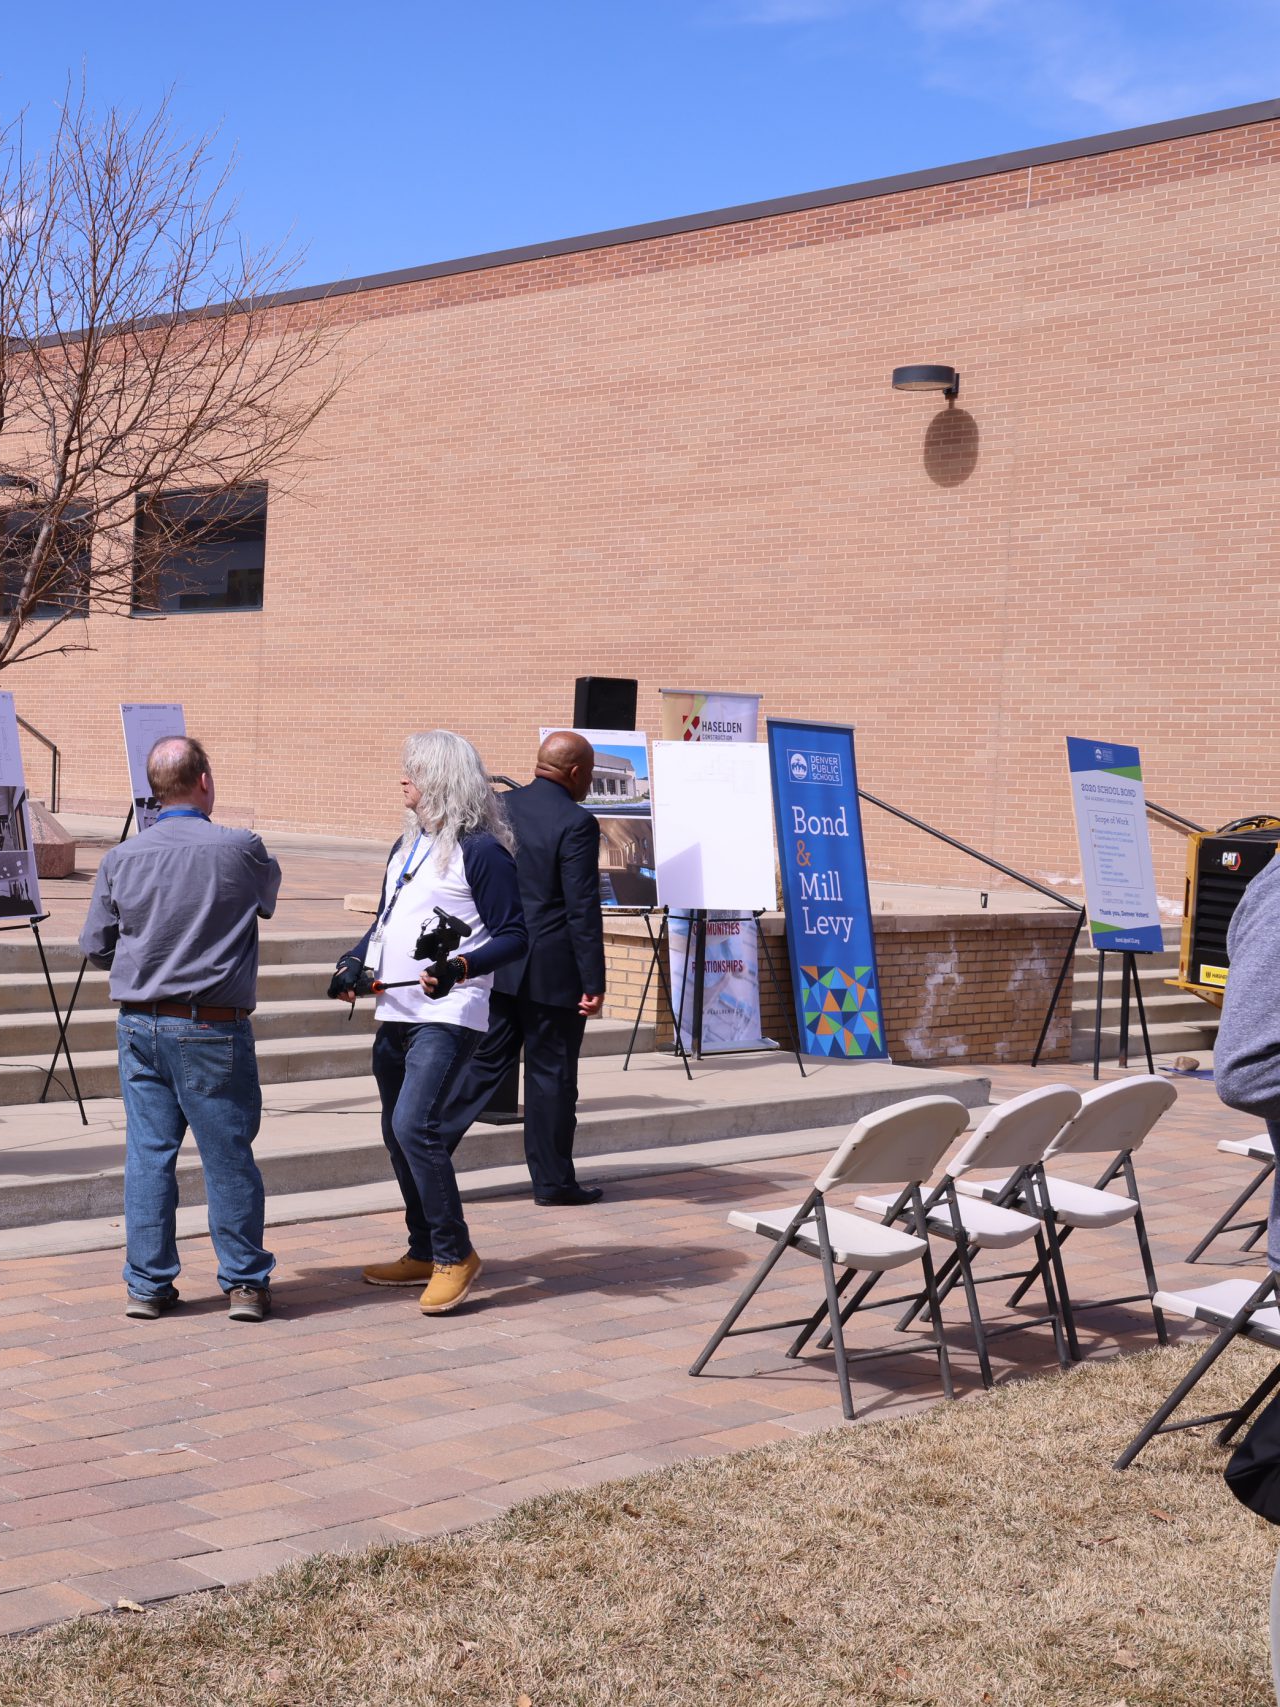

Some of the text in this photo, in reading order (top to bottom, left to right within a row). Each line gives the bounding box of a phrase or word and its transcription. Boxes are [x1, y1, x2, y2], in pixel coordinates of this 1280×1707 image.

[701, 720, 742, 733] HASELDEN
[810, 755, 838, 766] DENVER
[811, 764, 839, 775] PUBLIC
[812, 773, 840, 783] SCHOOLS
[1081, 783, 1097, 792] 2020
[792, 805, 849, 837] Bond
[796, 839, 812, 867] &
[1222, 852, 1237, 866] CAT
[798, 870, 844, 902] Mill
[802, 906, 853, 942] Levy
[691, 959, 743, 974] RATIONSHIPS
